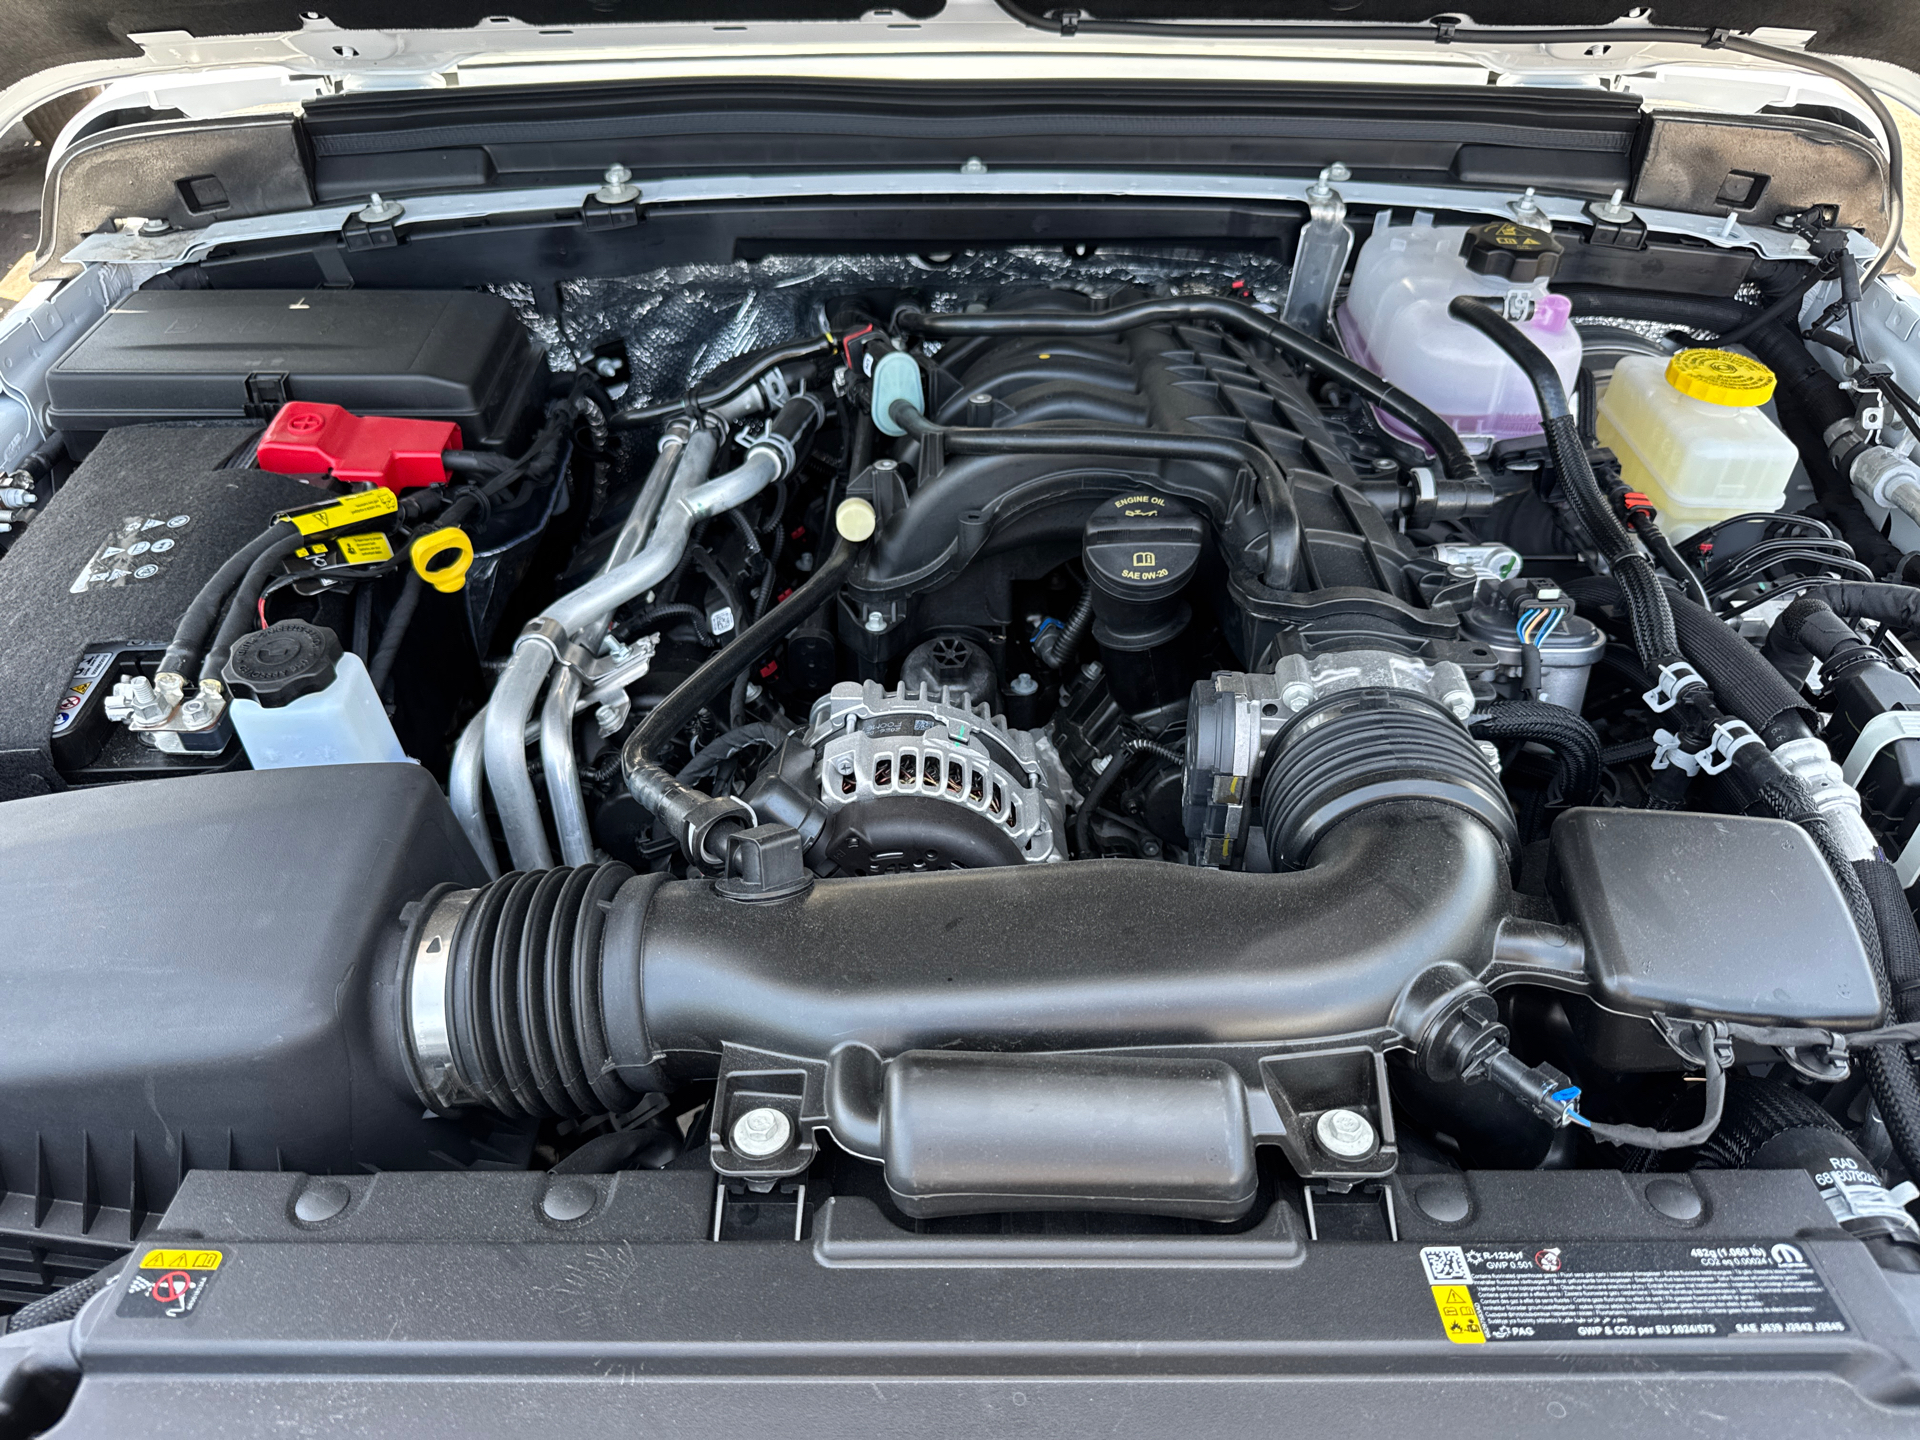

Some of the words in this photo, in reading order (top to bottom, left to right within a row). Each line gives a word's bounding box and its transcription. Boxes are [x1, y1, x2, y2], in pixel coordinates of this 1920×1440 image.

[1114, 495, 1149, 508] ENGINE
[1150, 496, 1166, 507] OIL
[1121, 569, 1141, 580] SAE
[1141, 568, 1169, 580] 0W-20
[1829, 1157, 1859, 1170] RAD
[1483, 1250, 1524, 1262] R-1234yf
[1700, 1257, 1721, 1266] CO2
[1486, 1261, 1509, 1270] GWP
[1509, 1260, 1534, 1270] 0.501
[1511, 1327, 1536, 1337] PAG
[1577, 1326, 1603, 1336] GWP
[1613, 1325, 1636, 1335] CO2
[1637, 1326, 1654, 1336] per
[1655, 1324, 1671, 1334] EU
[1735, 1322, 1757, 1333] SAE
